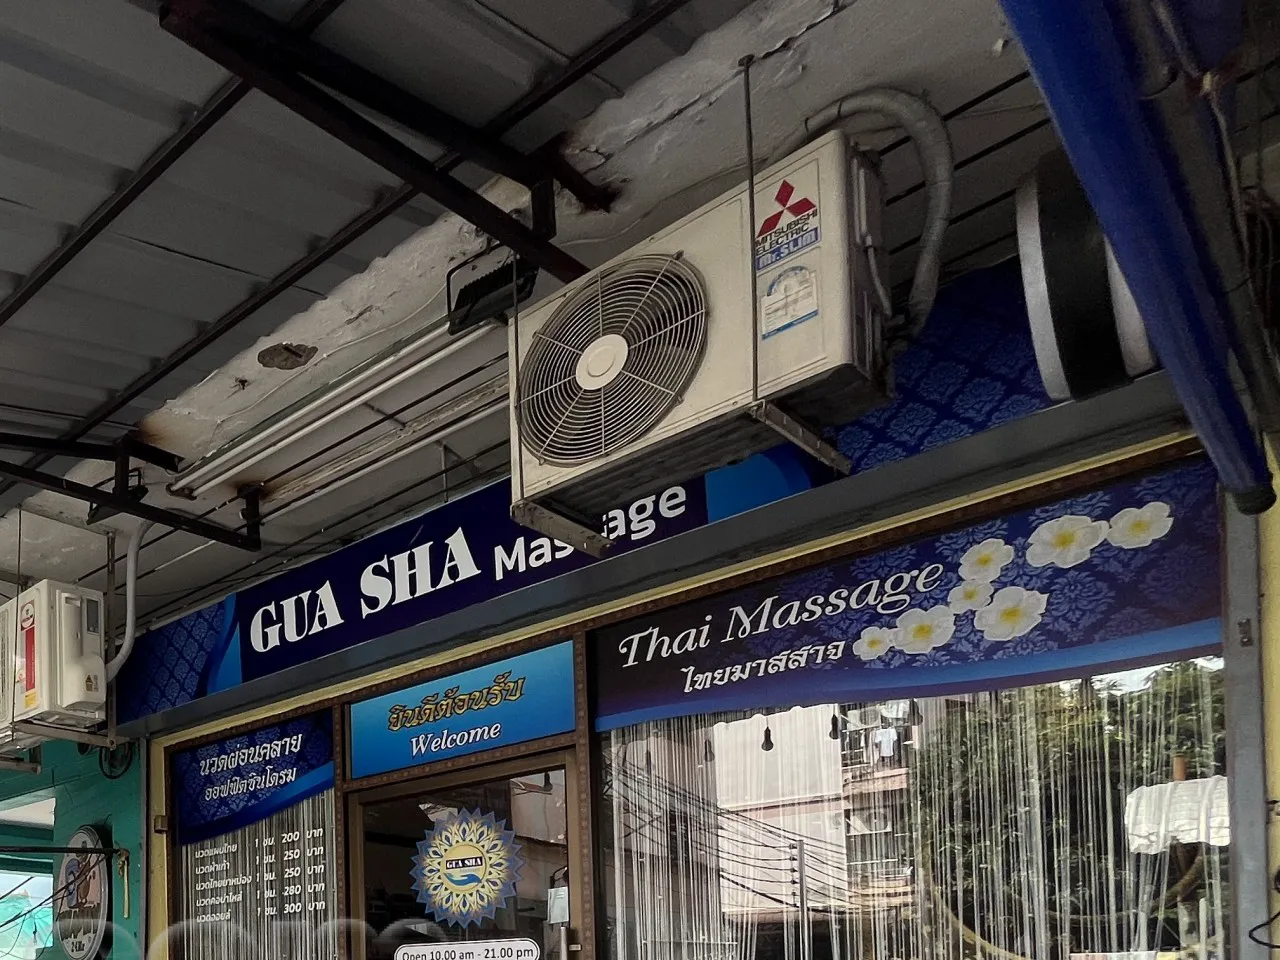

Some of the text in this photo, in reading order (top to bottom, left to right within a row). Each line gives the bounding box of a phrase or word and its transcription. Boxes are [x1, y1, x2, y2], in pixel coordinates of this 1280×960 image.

[756, 209, 818, 246] MITSUBISHI
[756, 223, 810, 255] ELECTRIC
[250, 485, 687, 653] GUA SHA Masage
[618, 563, 944, 667] Thai Massage
[388, 670, 526, 731] ยินดีต้อนรับ
[200, 733, 302, 776] นวดผ่อนคลาย
[411, 722, 501, 760] Welcome
[281, 831, 300, 843] 200
[306, 828, 323, 838] บาท
[284, 849, 300, 860] 250
[306, 846, 324, 856] บาท
[284, 867, 301, 878] 250
[307, 864, 324, 874] บาท
[283, 885, 301, 896] 280
[308, 882, 325, 892] บาท
[284, 902, 302, 913] 300
[308, 901, 325, 911] บาท
[430, 950, 456, 960] 10.00
[458, 952, 474, 960] am
[484, 947, 512, 959] 21.00
[516, 948, 534, 960] pm
